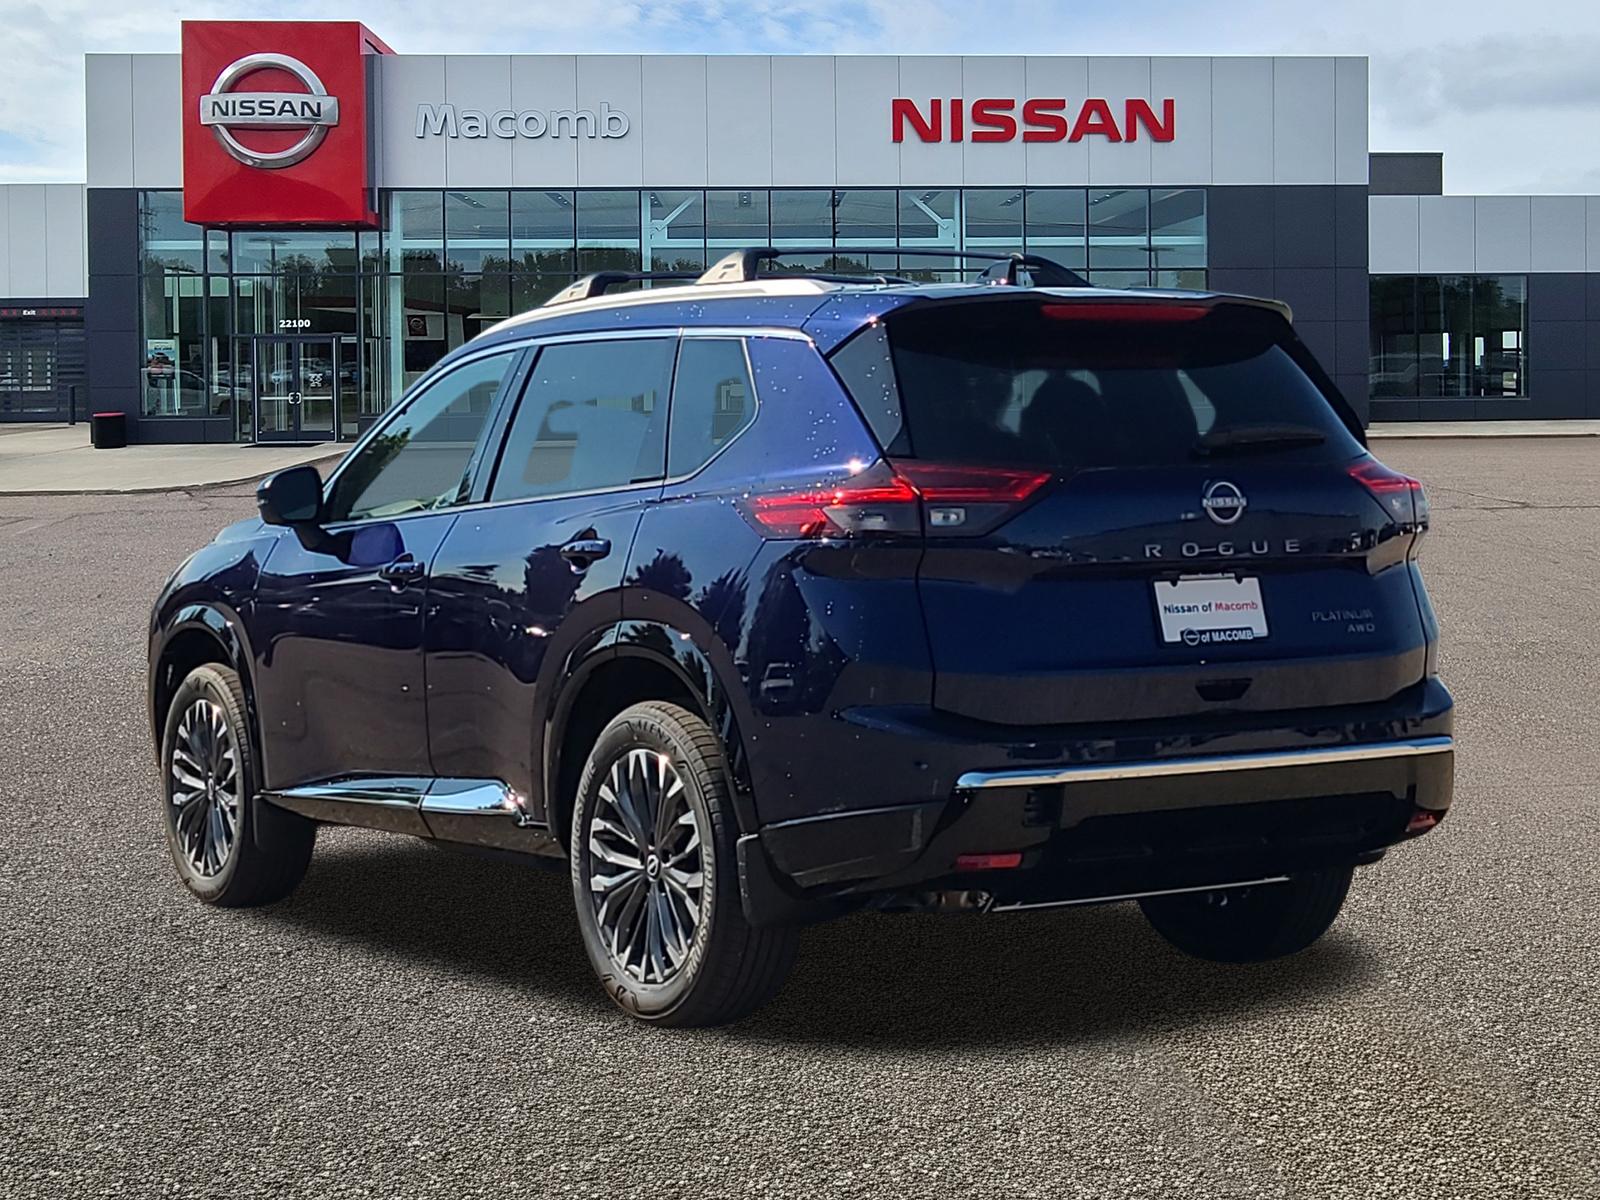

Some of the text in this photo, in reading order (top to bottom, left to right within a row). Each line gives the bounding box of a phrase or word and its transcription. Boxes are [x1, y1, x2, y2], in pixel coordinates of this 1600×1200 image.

[211, 99, 323, 119] NISSAN
[415, 102, 630, 139] Macomb
[892, 98, 1175, 143] NISSAN
[279, 318, 311, 329] 22100
[1202, 497, 1247, 508] NISSAN
[1144, 539, 1301, 558] ROGUE
[1163, 600, 1258, 614] Nissan of Macomb
[1311, 608, 1374, 622] PLATINUM
[1347, 623, 1375, 633] AWD
[1201, 629, 1254, 643] of MACOMB
